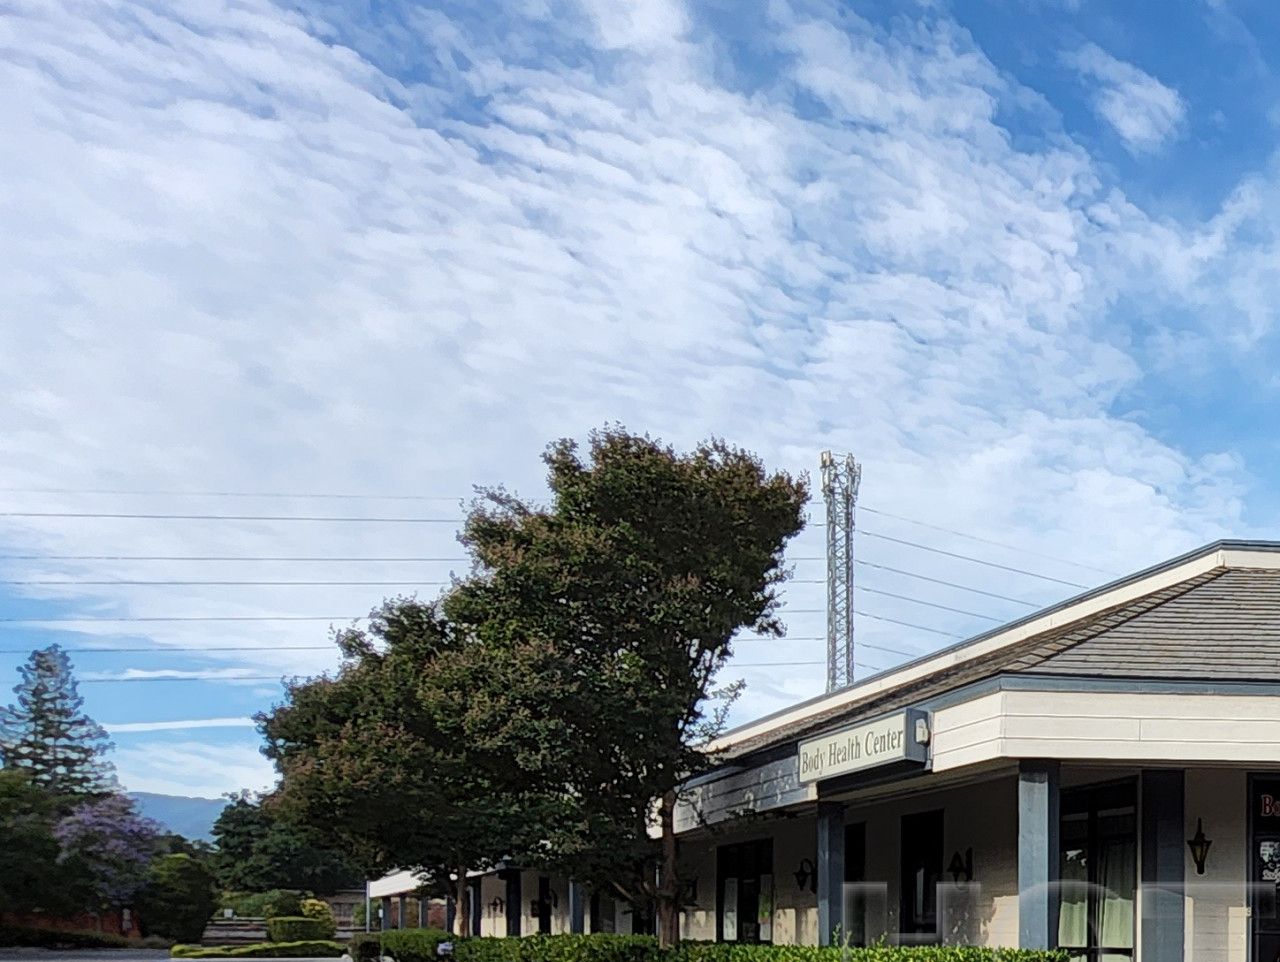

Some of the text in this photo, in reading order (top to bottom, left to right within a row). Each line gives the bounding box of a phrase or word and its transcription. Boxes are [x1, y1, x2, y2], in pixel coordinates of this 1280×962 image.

[802, 728, 904, 775] Body Health Center
